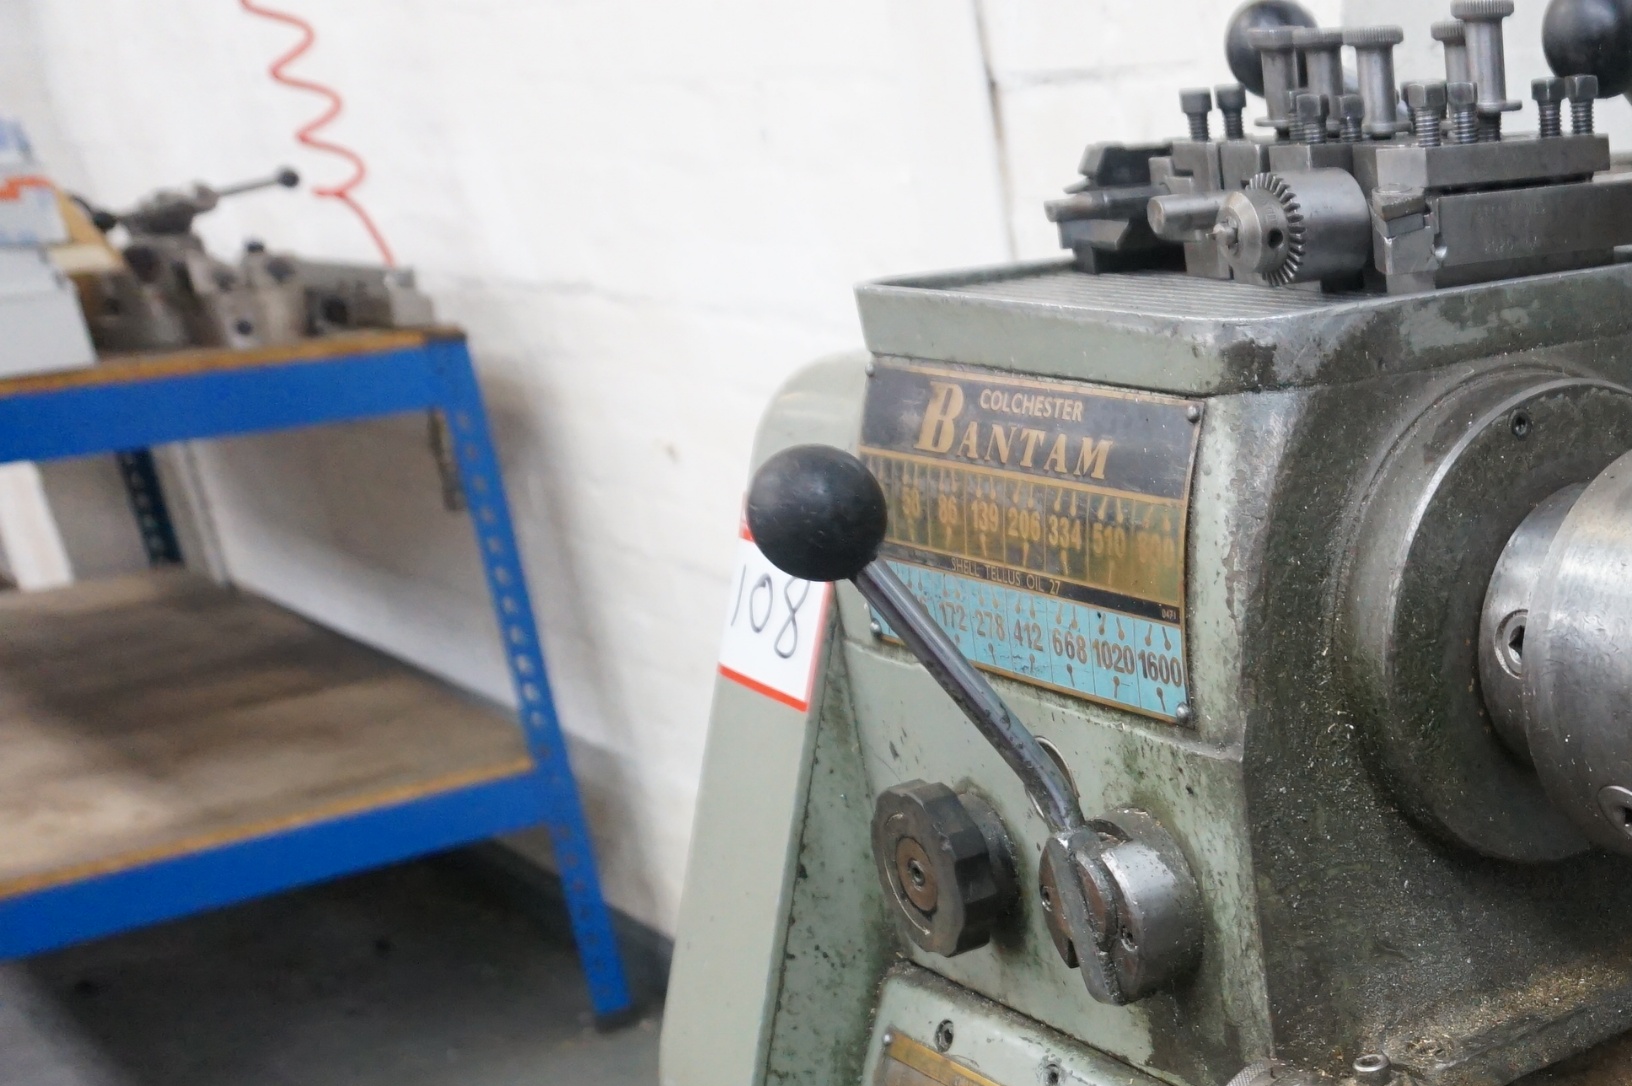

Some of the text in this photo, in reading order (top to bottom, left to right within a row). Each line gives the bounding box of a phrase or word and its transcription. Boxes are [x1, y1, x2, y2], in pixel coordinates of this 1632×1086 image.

[914, 381, 1113, 479] BANTAM
[980, 389, 1083, 421] COLCHESTER
[971, 500, 999, 532] 139
[1008, 506, 1041, 541] 206
[1049, 514, 1082, 551] 334
[1093, 522, 1126, 558] 510
[731, 564, 811, 659] 108
[951, 557, 1061, 595] SHELL TELLUS OIL 27
[939, 601, 967, 631] 172
[975, 609, 1005, 641] 278
[1014, 619, 1043, 651] 412
[1052, 628, 1087, 664] 668
[1092, 638, 1135, 674] 1020
[1138, 649, 1182, 687] 1600
